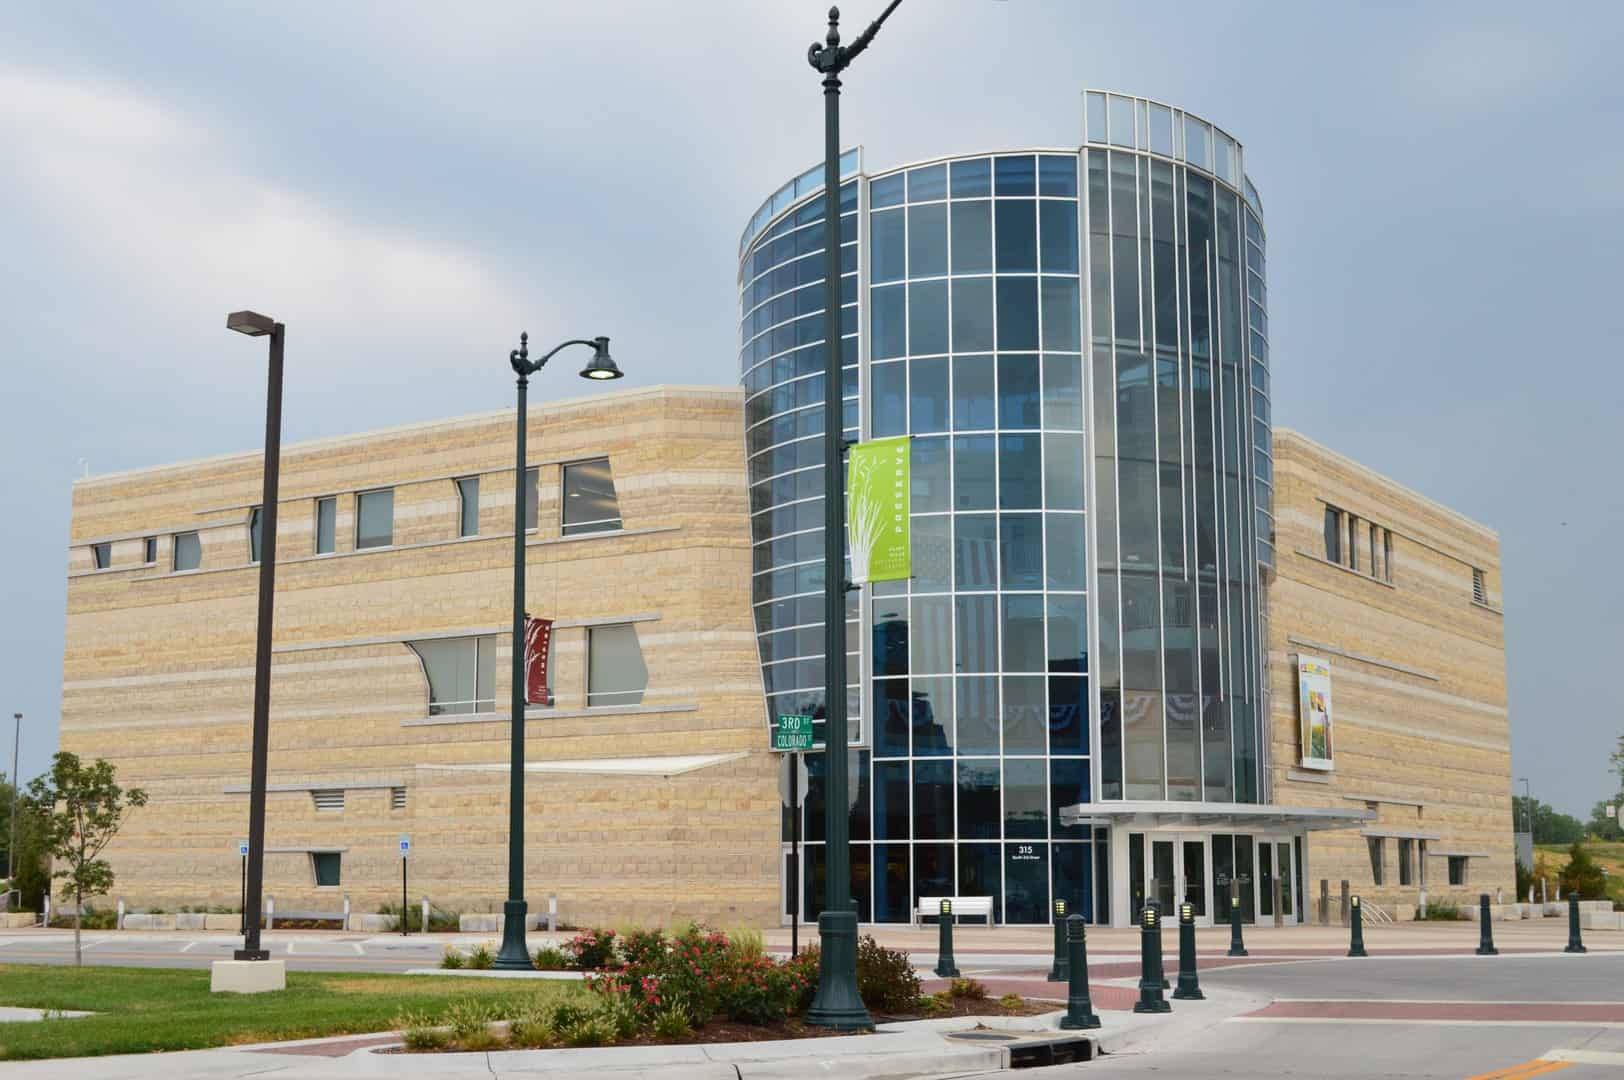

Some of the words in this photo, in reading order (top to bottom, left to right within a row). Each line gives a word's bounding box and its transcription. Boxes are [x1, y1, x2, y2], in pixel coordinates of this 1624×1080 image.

[895, 446, 904, 533] PRESERVE
[782, 716, 800, 729] 3RD
[778, 735, 807, 747] COLORADO
[1018, 846, 1032, 854] 315
